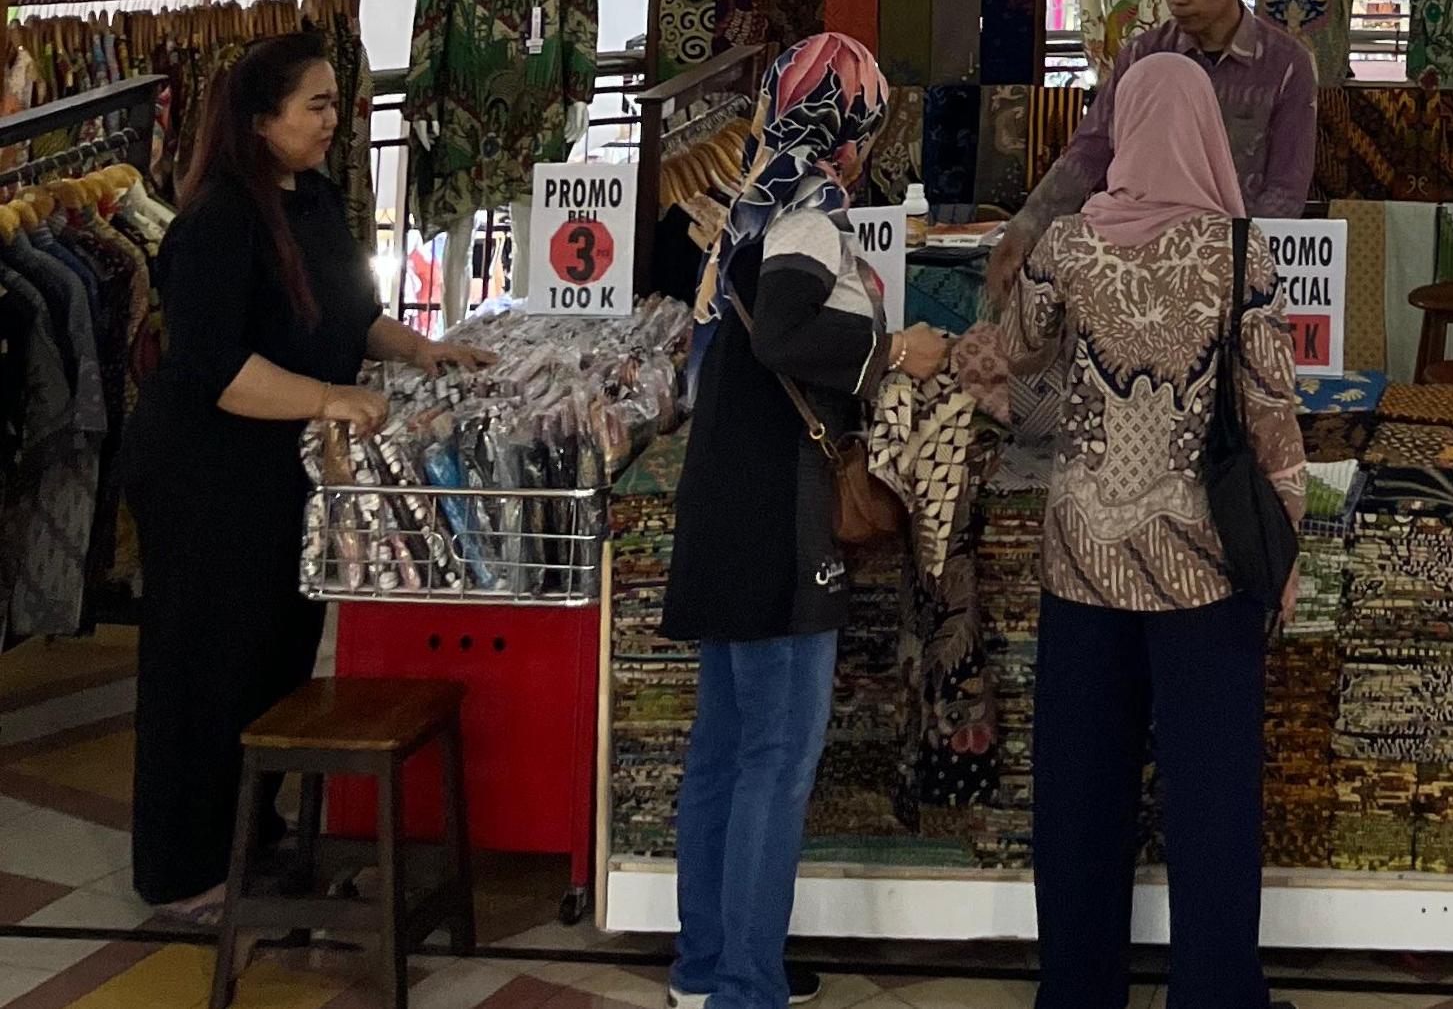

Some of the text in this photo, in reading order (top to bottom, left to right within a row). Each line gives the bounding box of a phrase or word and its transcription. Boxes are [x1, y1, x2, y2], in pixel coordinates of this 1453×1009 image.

[545, 178, 622, 208] PROMO
[568, 210, 597, 223] BELI
[566, 226, 595, 282] 3
[1269, 235, 1333, 267] ROMO
[550, 287, 615, 309] 100 K
